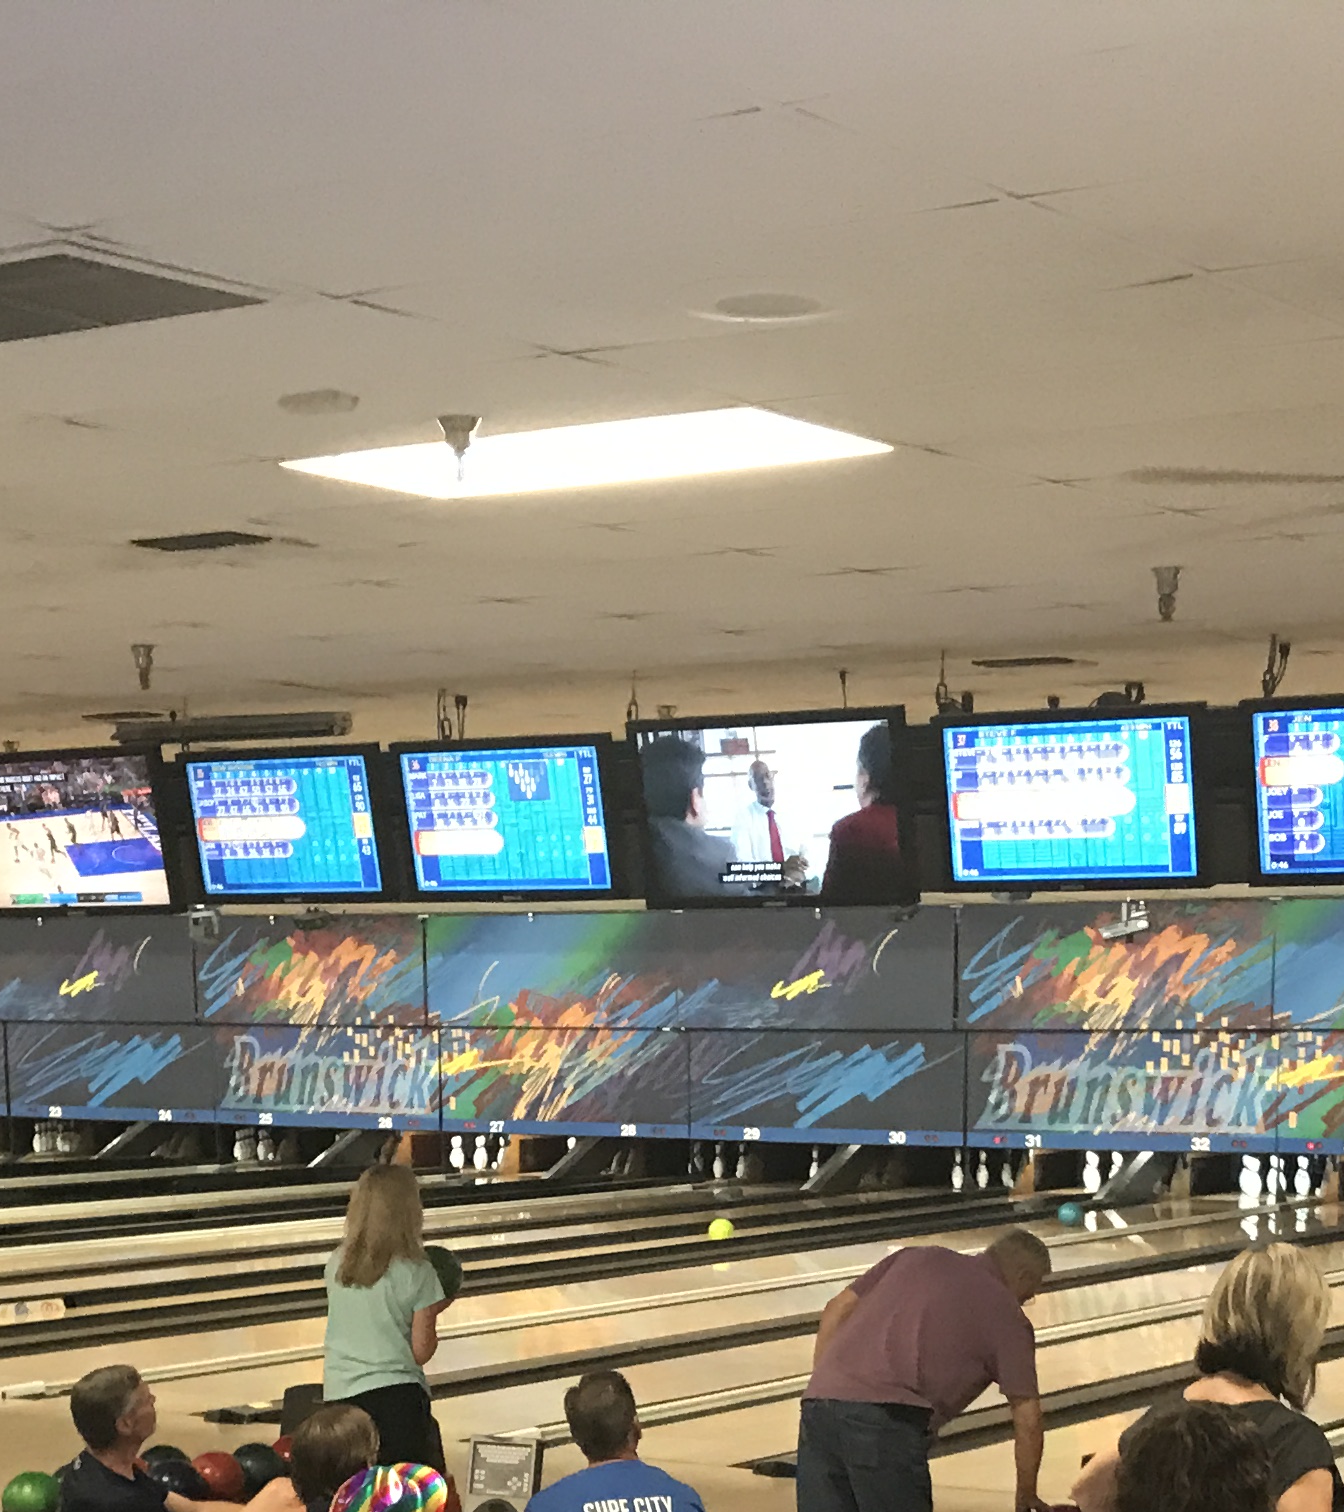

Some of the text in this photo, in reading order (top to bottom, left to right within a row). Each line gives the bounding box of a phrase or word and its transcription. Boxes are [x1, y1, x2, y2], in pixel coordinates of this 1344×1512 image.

[1293, 715, 1311, 723] JEN
[1166, 722, 1183, 730] TTL
[1266, 787, 1288, 796] JOEY
[1267, 810, 1284, 819] JOE
[224, 1035, 433, 1109] Brunswick
[981, 1042, 1267, 1128] Brunswick
[48, 1106, 62, 1118] 23
[158, 1109, 172, 1122] 24
[258, 1112, 273, 1125] 25
[378, 1117, 393, 1129] 26
[489, 1120, 505, 1133] 27
[620, 1124, 637, 1137] 28
[743, 1127, 760, 1140] 29
[888, 1130, 906, 1145] 30
[1025, 1133, 1042, 1148] 31
[1191, 1137, 1211, 1152] 32
